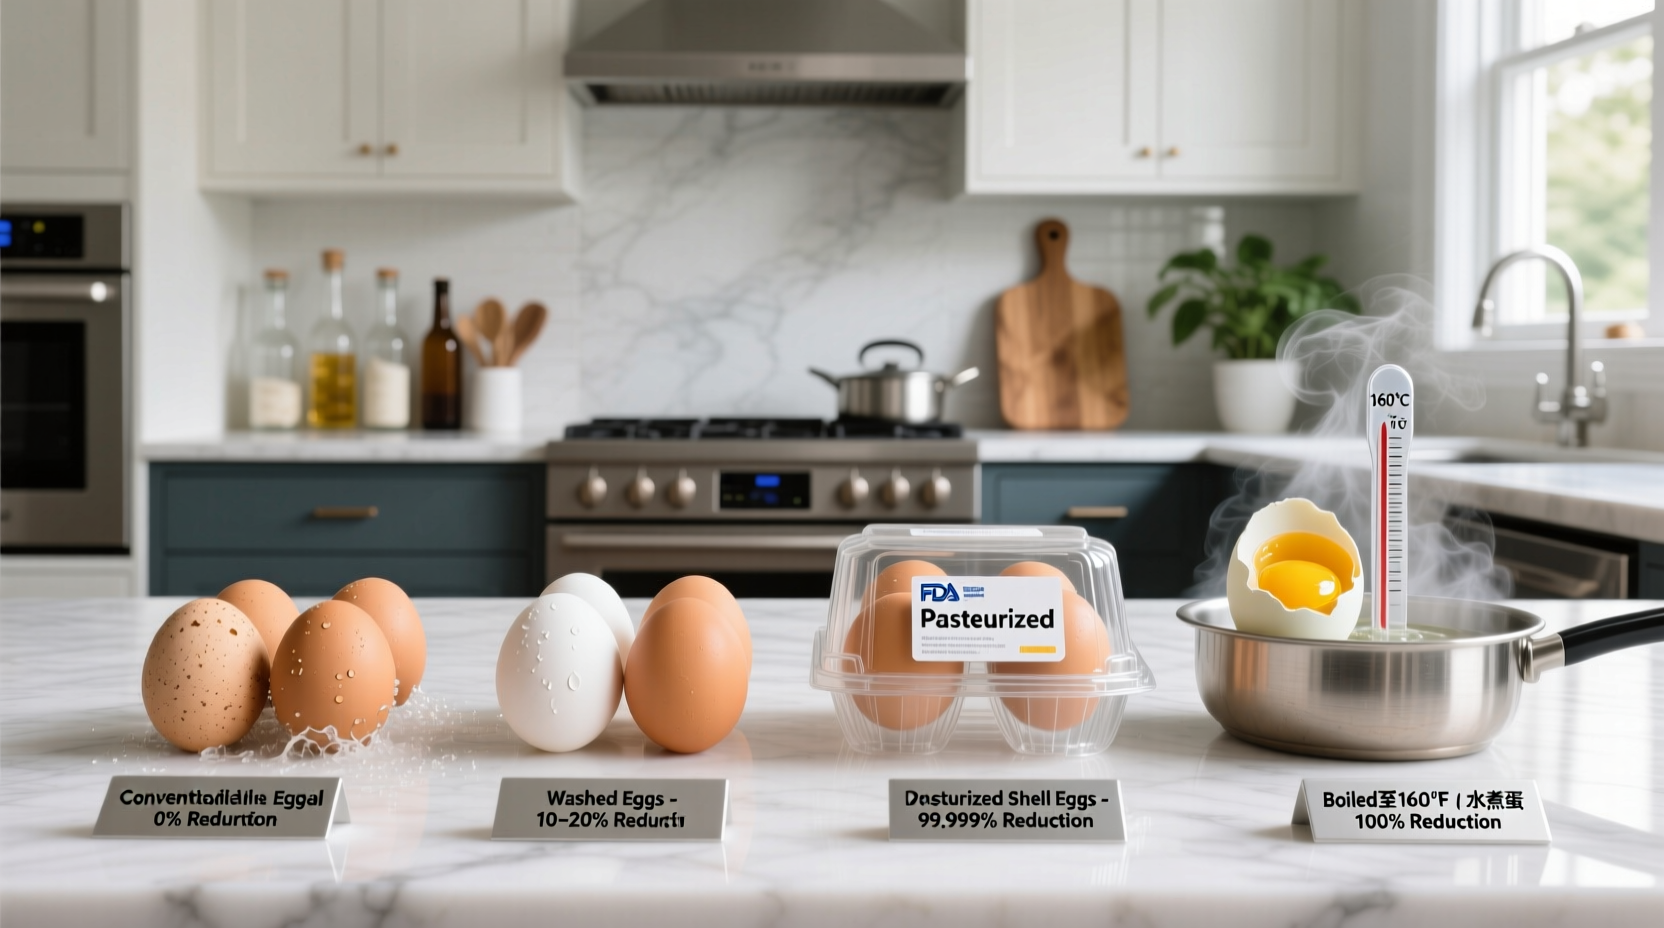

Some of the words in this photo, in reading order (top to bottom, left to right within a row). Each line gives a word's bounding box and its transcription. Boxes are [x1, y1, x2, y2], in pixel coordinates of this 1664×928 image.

[921, 583, 960, 602] FDA
[921, 608, 1055, 629] Pasteurized
[547, 789, 618, 806] Washed
[622, 790, 665, 810] Eggs
[1008, 789, 1051, 806] Shell
[1055, 790, 1097, 811] Eggs
[1466, 789, 1524, 810] 水煮蛋
[153, 811, 182, 827] 0%
[918, 811, 998, 829] 99.999%
[1002, 811, 1094, 828] Reduction
[1355, 813, 1405, 829] 100%
[1410, 813, 1502, 829] Reduction
